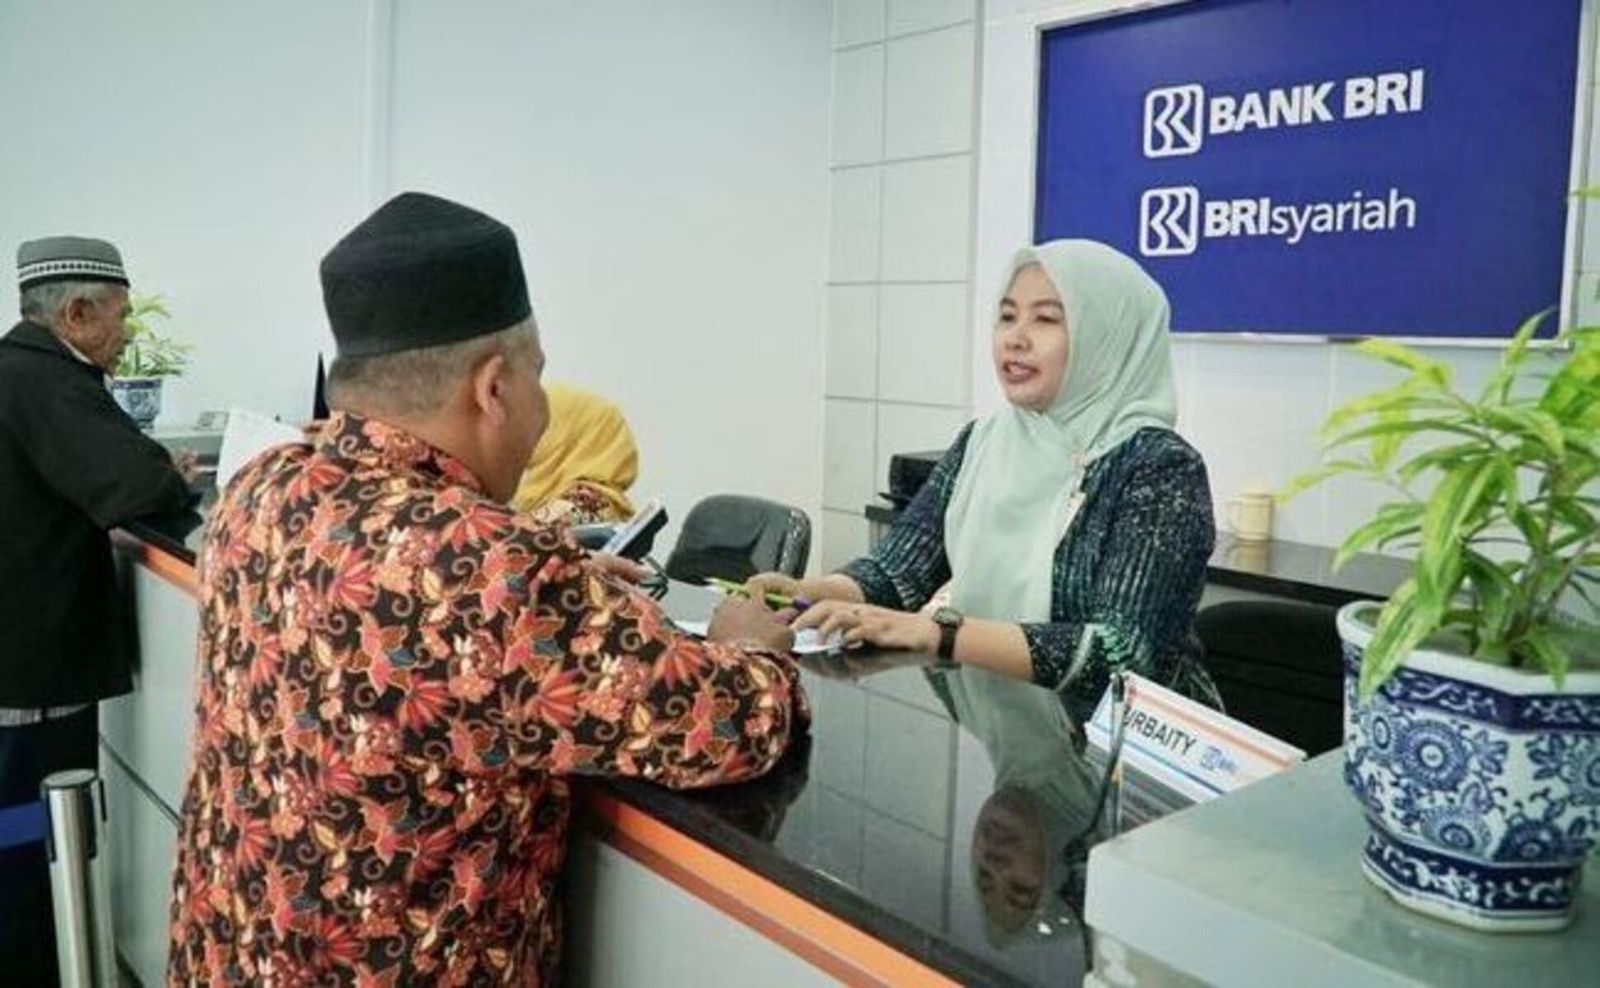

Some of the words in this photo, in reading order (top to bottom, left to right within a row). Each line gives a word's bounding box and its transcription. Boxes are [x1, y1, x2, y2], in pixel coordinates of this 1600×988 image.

[1209, 81, 1335, 134] BANK
[1344, 69, 1424, 119] BRI
[1204, 188, 1416, 243] BRIsyariah
[1122, 705, 1197, 755] URBAITY
